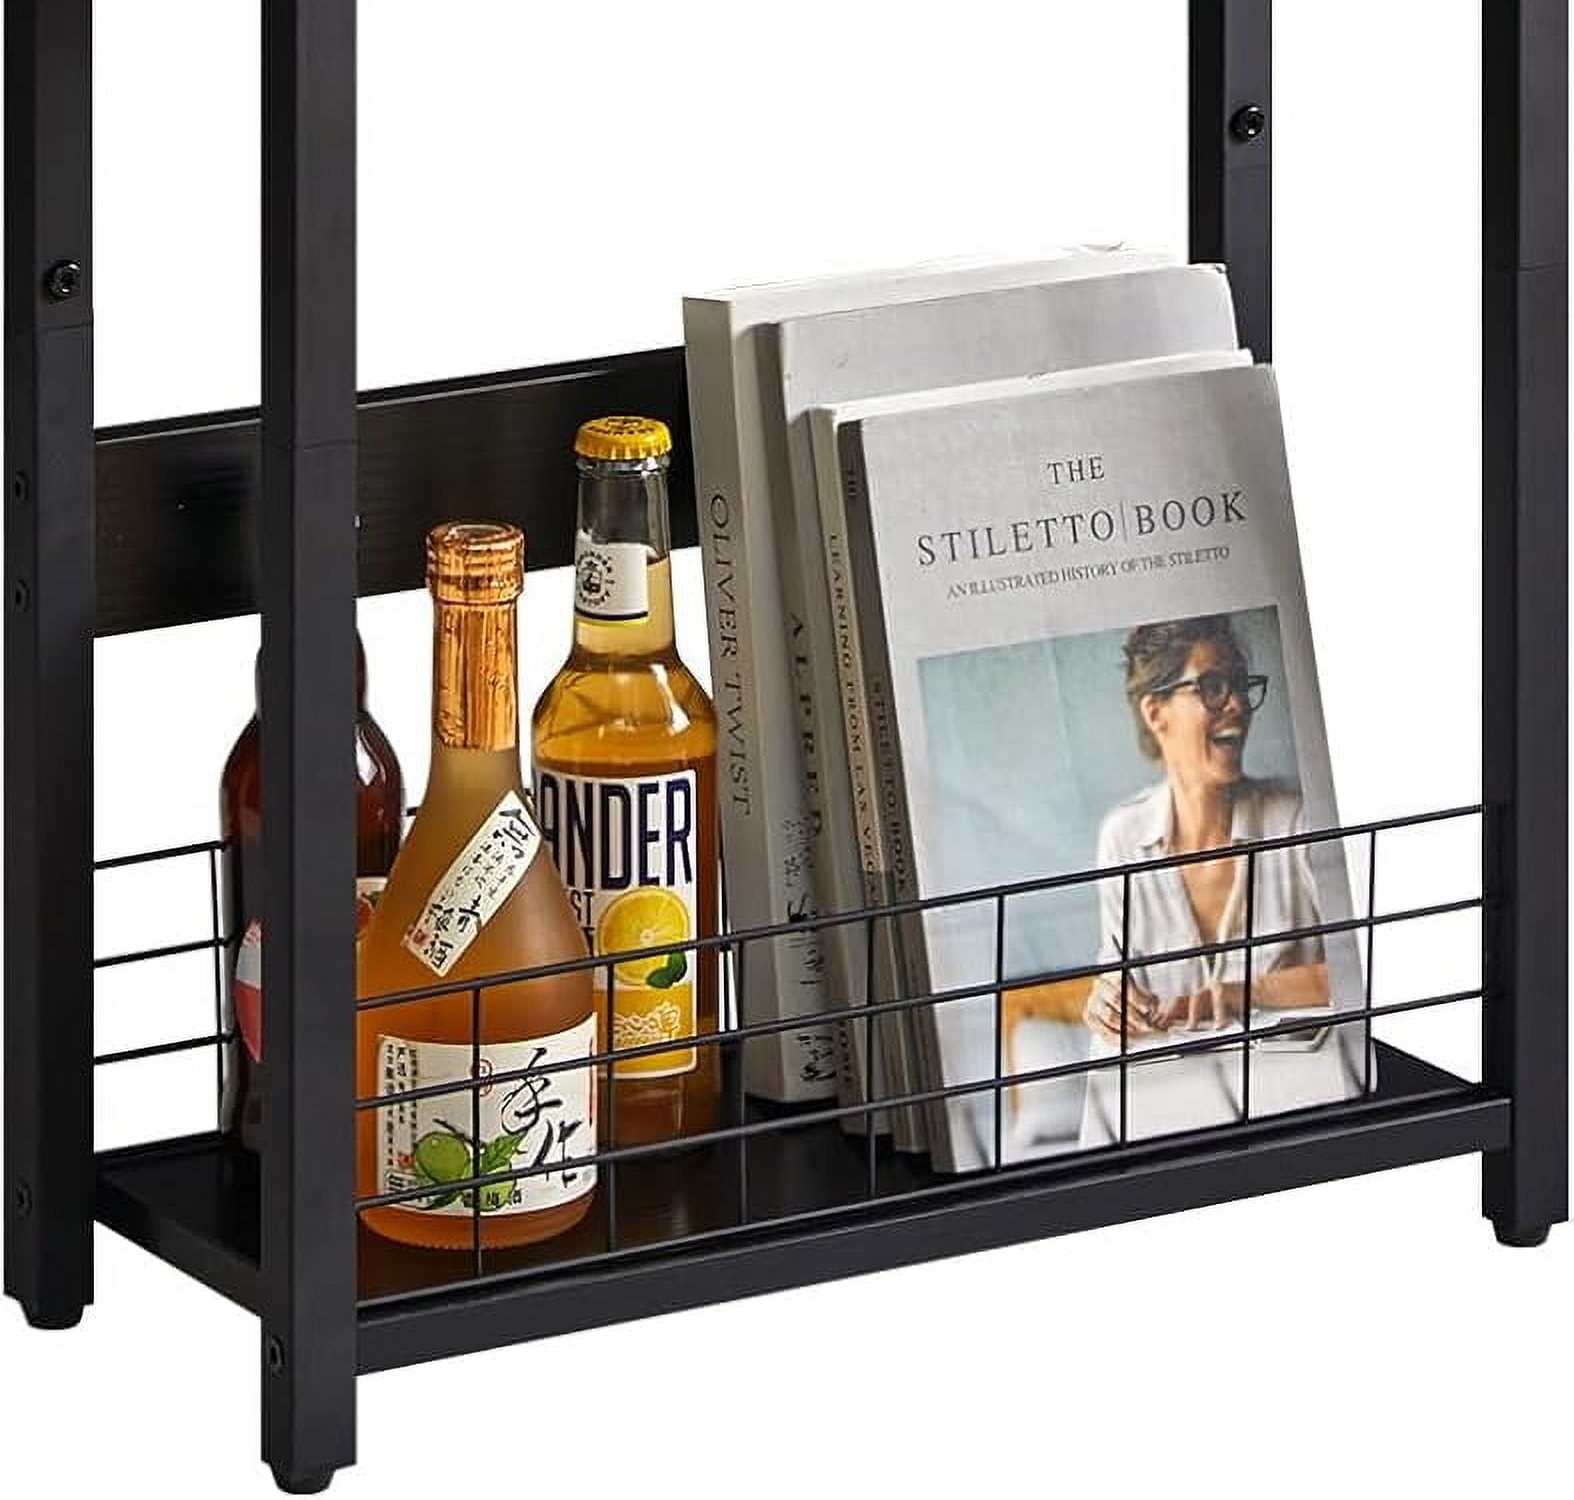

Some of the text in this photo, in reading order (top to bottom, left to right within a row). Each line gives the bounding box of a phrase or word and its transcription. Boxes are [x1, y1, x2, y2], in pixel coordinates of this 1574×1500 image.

[1047, 456, 1105, 485] THE
[917, 490, 1247, 566] STILETTO BOOK
[967, 569, 1060, 595] ILLUSTRATED
[1061, 560, 1119, 583] HISTORY
[1168, 546, 1231, 568] STILETTO
[709, 493, 751, 816] OLIVER TWIST
[830, 533, 854, 679] LEARNING
[846, 680, 862, 754] FROM
